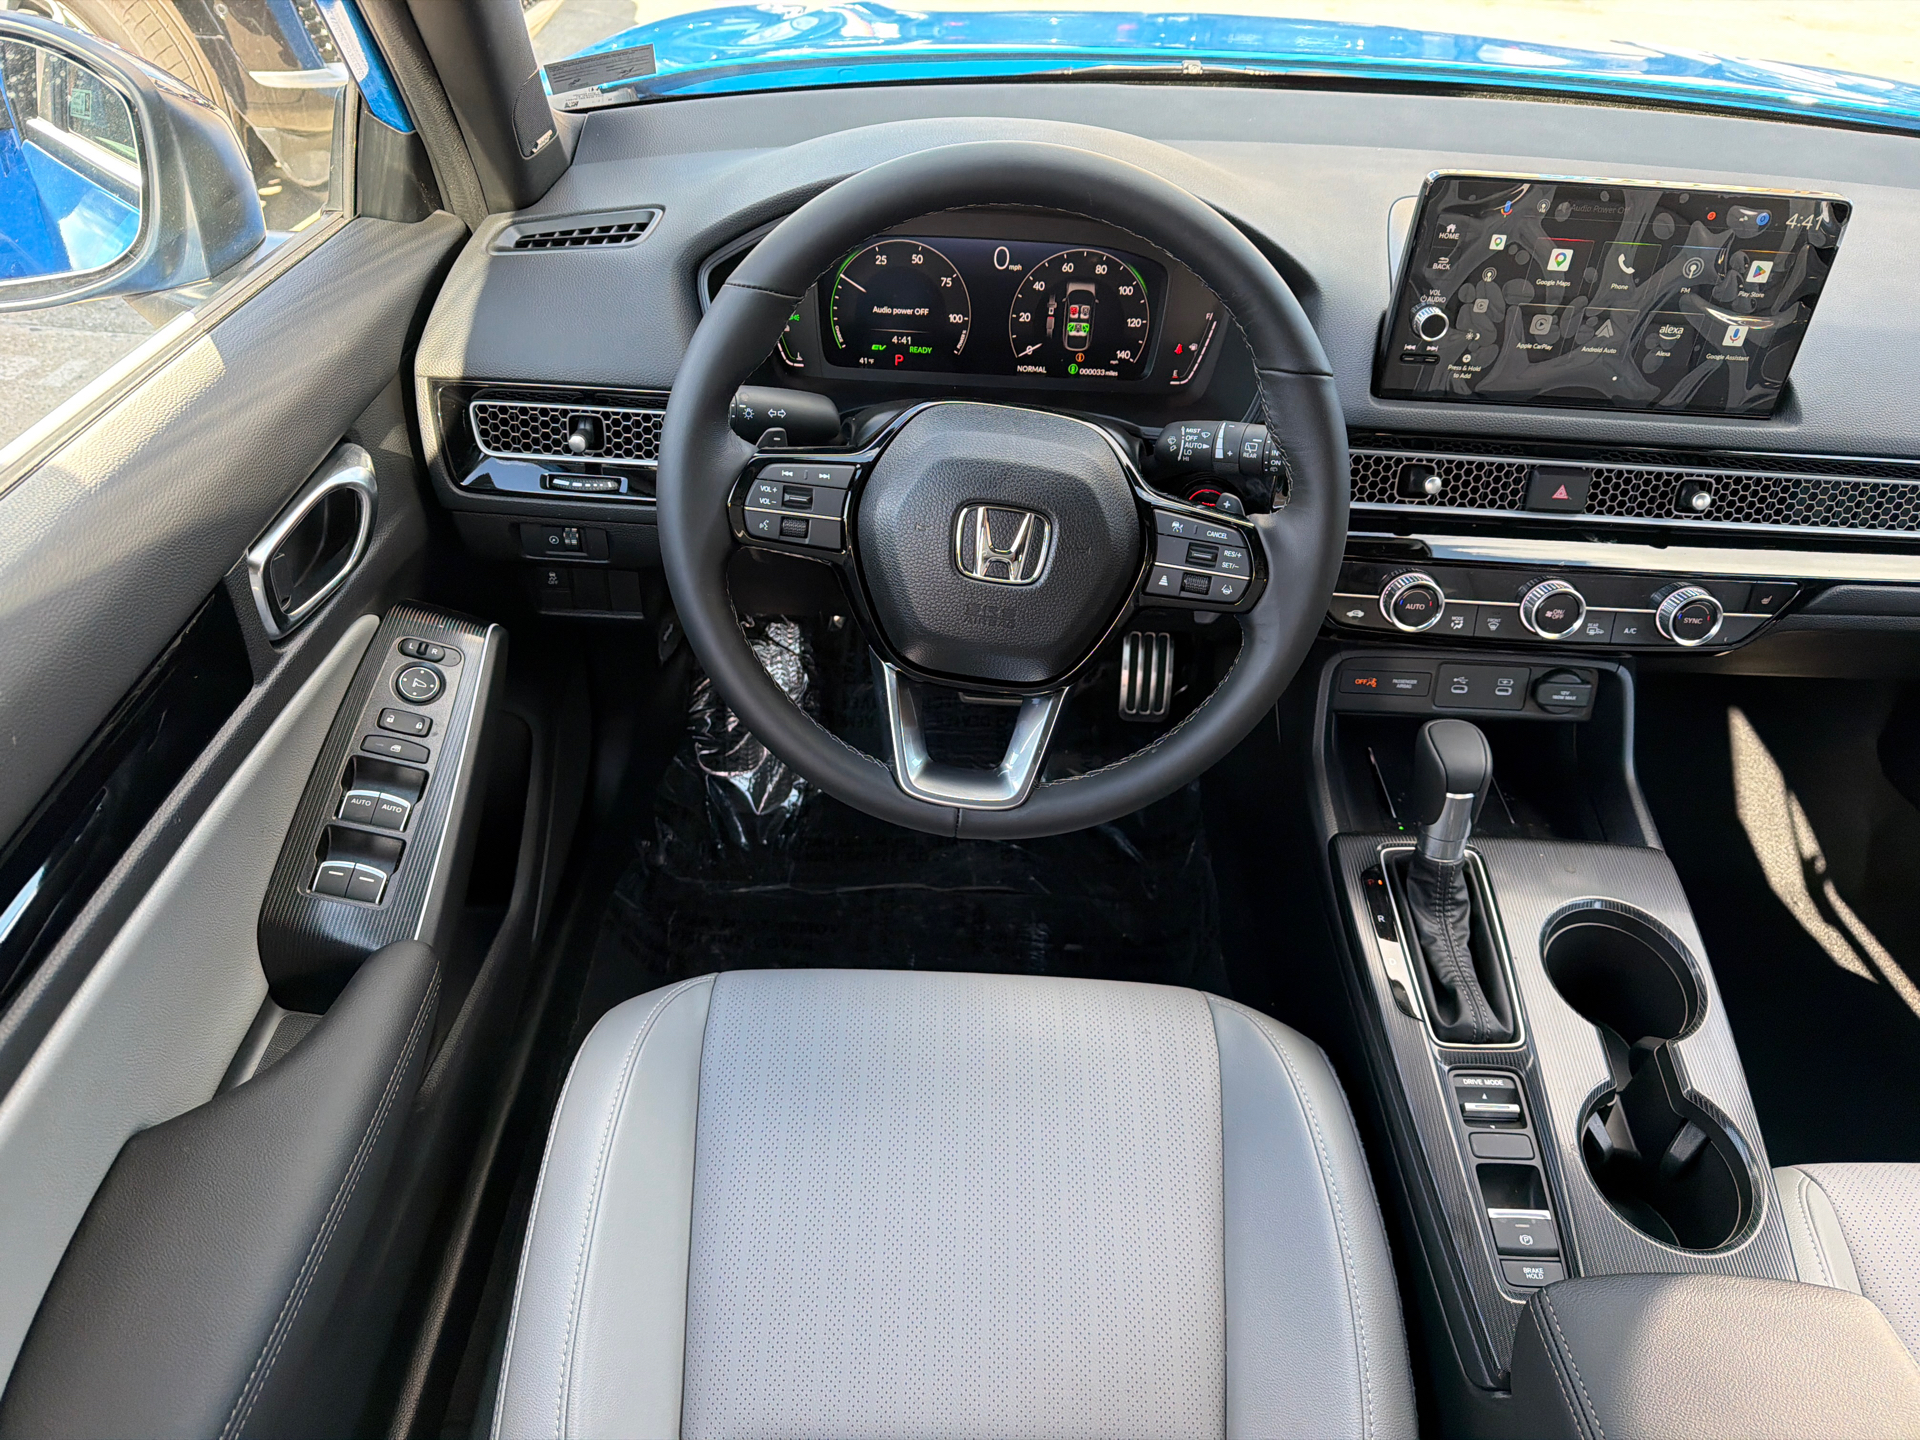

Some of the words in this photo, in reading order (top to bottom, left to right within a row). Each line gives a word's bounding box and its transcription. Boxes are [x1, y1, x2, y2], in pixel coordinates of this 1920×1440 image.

[1785, 213, 1824, 231] 4:41
[1438, 232, 1460, 240] HOME
[875, 255, 888, 265] 25
[911, 254, 924, 264] 50
[993, 246, 1010, 270] 0
[1008, 264, 1022, 272] mph
[1061, 262, 1074, 273] 60
[1095, 264, 1108, 275] 80
[940, 277, 953, 287] 75
[1032, 281, 1045, 291] 40
[1535, 278, 1554, 287] Google
[1610, 283, 1629, 291] Phone
[1118, 286, 1133, 296] 100
[1737, 290, 1750, 298] Play
[872, 306, 892, 314] Audio
[893, 307, 913, 316] power
[914, 307, 930, 316] OFF
[949, 314, 963, 323] 100
[1018, 312, 1031, 322] 20
[1127, 318, 1142, 328] 120
[1659, 324, 1684, 335] alexa
[891, 335, 912, 345] 4:41
[909, 346, 933, 354] READY
[1516, 342, 1532, 350] Apple
[1532, 343, 1553, 351] CarPlay
[894, 354, 904, 366] P
[1116, 350, 1131, 360] 140
[1705, 353, 1725, 362] Google
[1016, 365, 1047, 374] NORMAL
[1079, 368, 1105, 376] 000033
[1206, 530, 1228, 540] CANCEL
[1683, 617, 1703, 625] SYNC
[408, 642, 414, 650] L
[431, 647, 439, 655] R
[350, 797, 372, 807] AUTO
[381, 803, 403, 813] AUTO
[1377, 914, 1386, 923] R
[1462, 1078, 1483, 1086] DRIVE
[1522, 1266, 1544, 1274] BRAKE
[1525, 1272, 1544, 1280] HOLD
